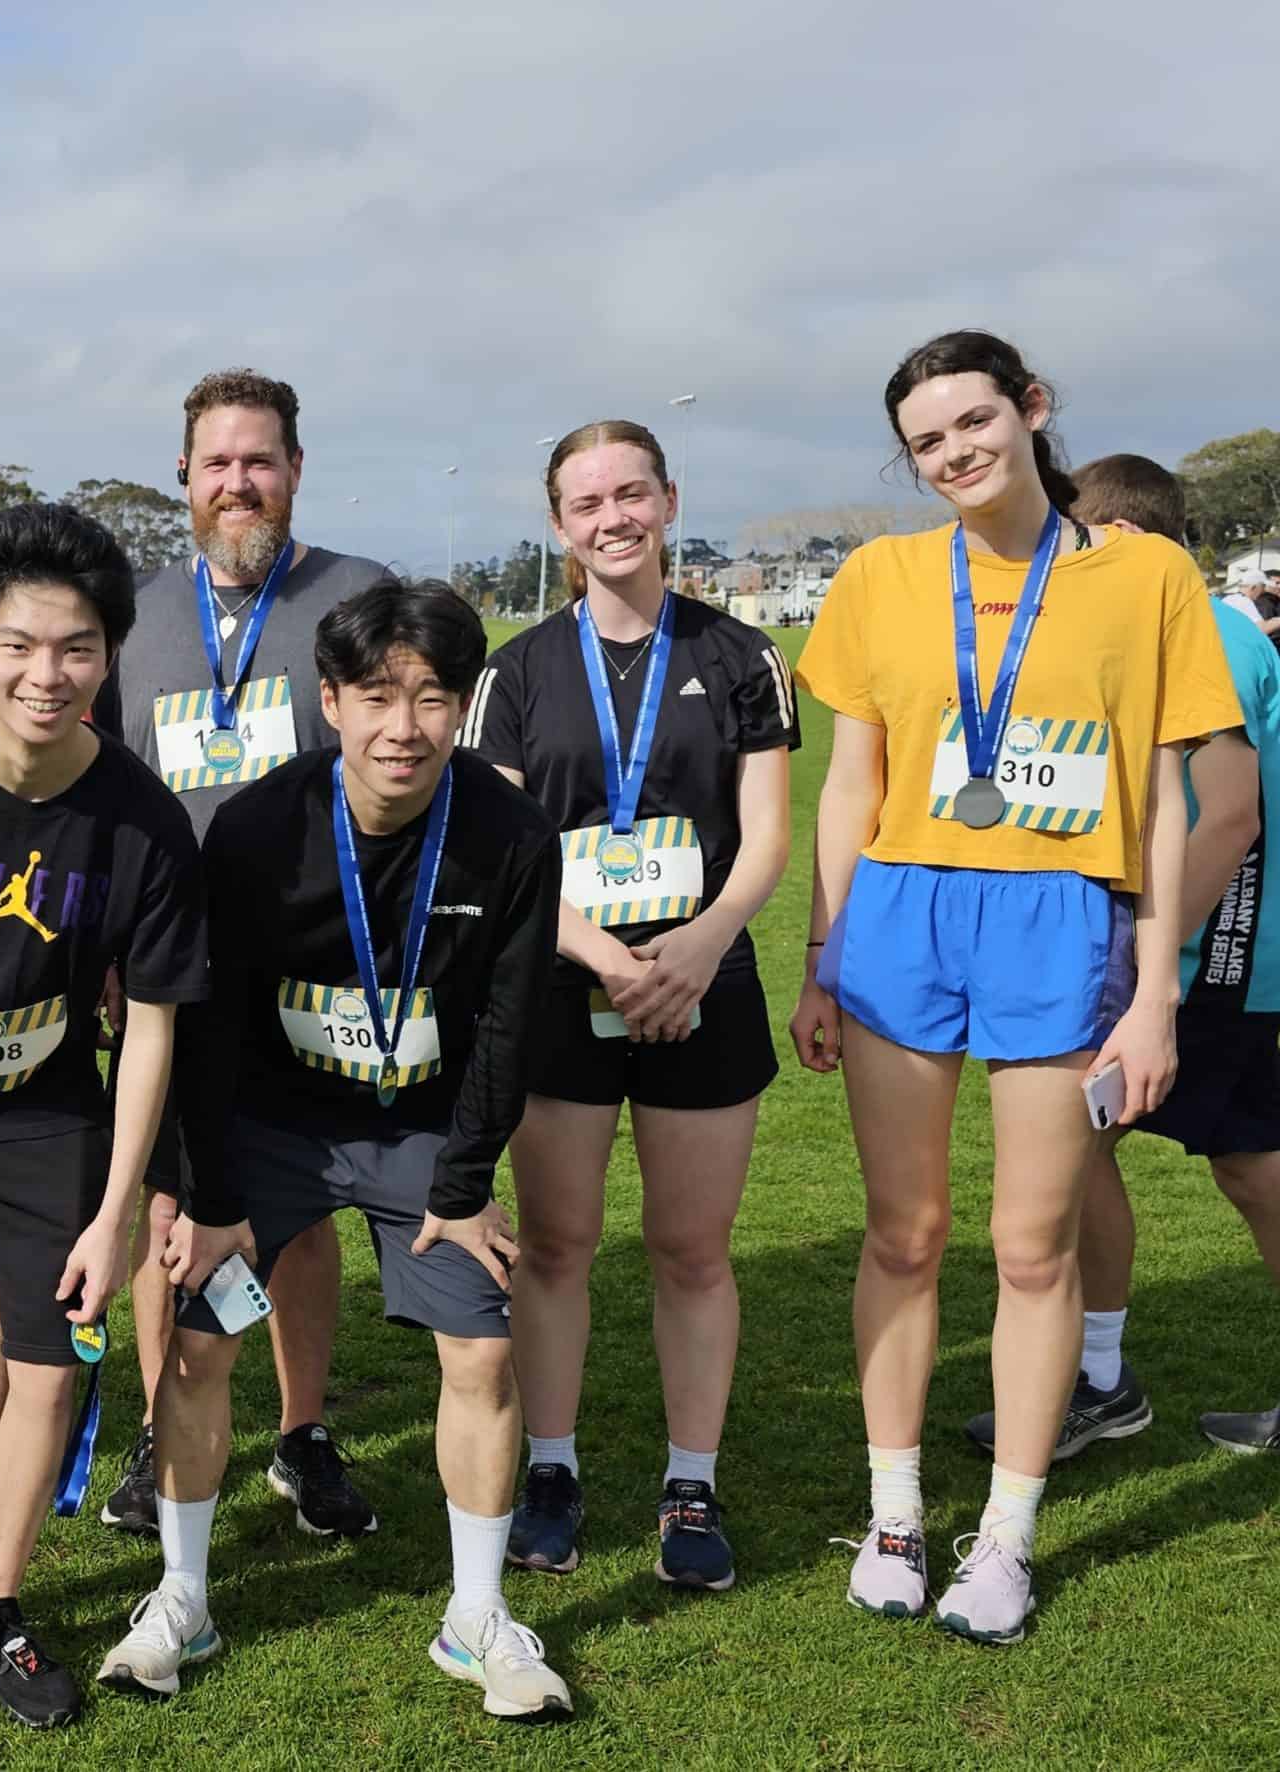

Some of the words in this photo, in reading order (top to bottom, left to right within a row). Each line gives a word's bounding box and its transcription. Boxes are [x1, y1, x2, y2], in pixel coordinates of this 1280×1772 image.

[194, 722, 255, 749] 14
[1000, 760, 1055, 788] 310
[1235, 866, 1257, 935] ALBANY
[1205, 934, 1231, 985] SERIES
[323, 1023, 391, 1049] 130
